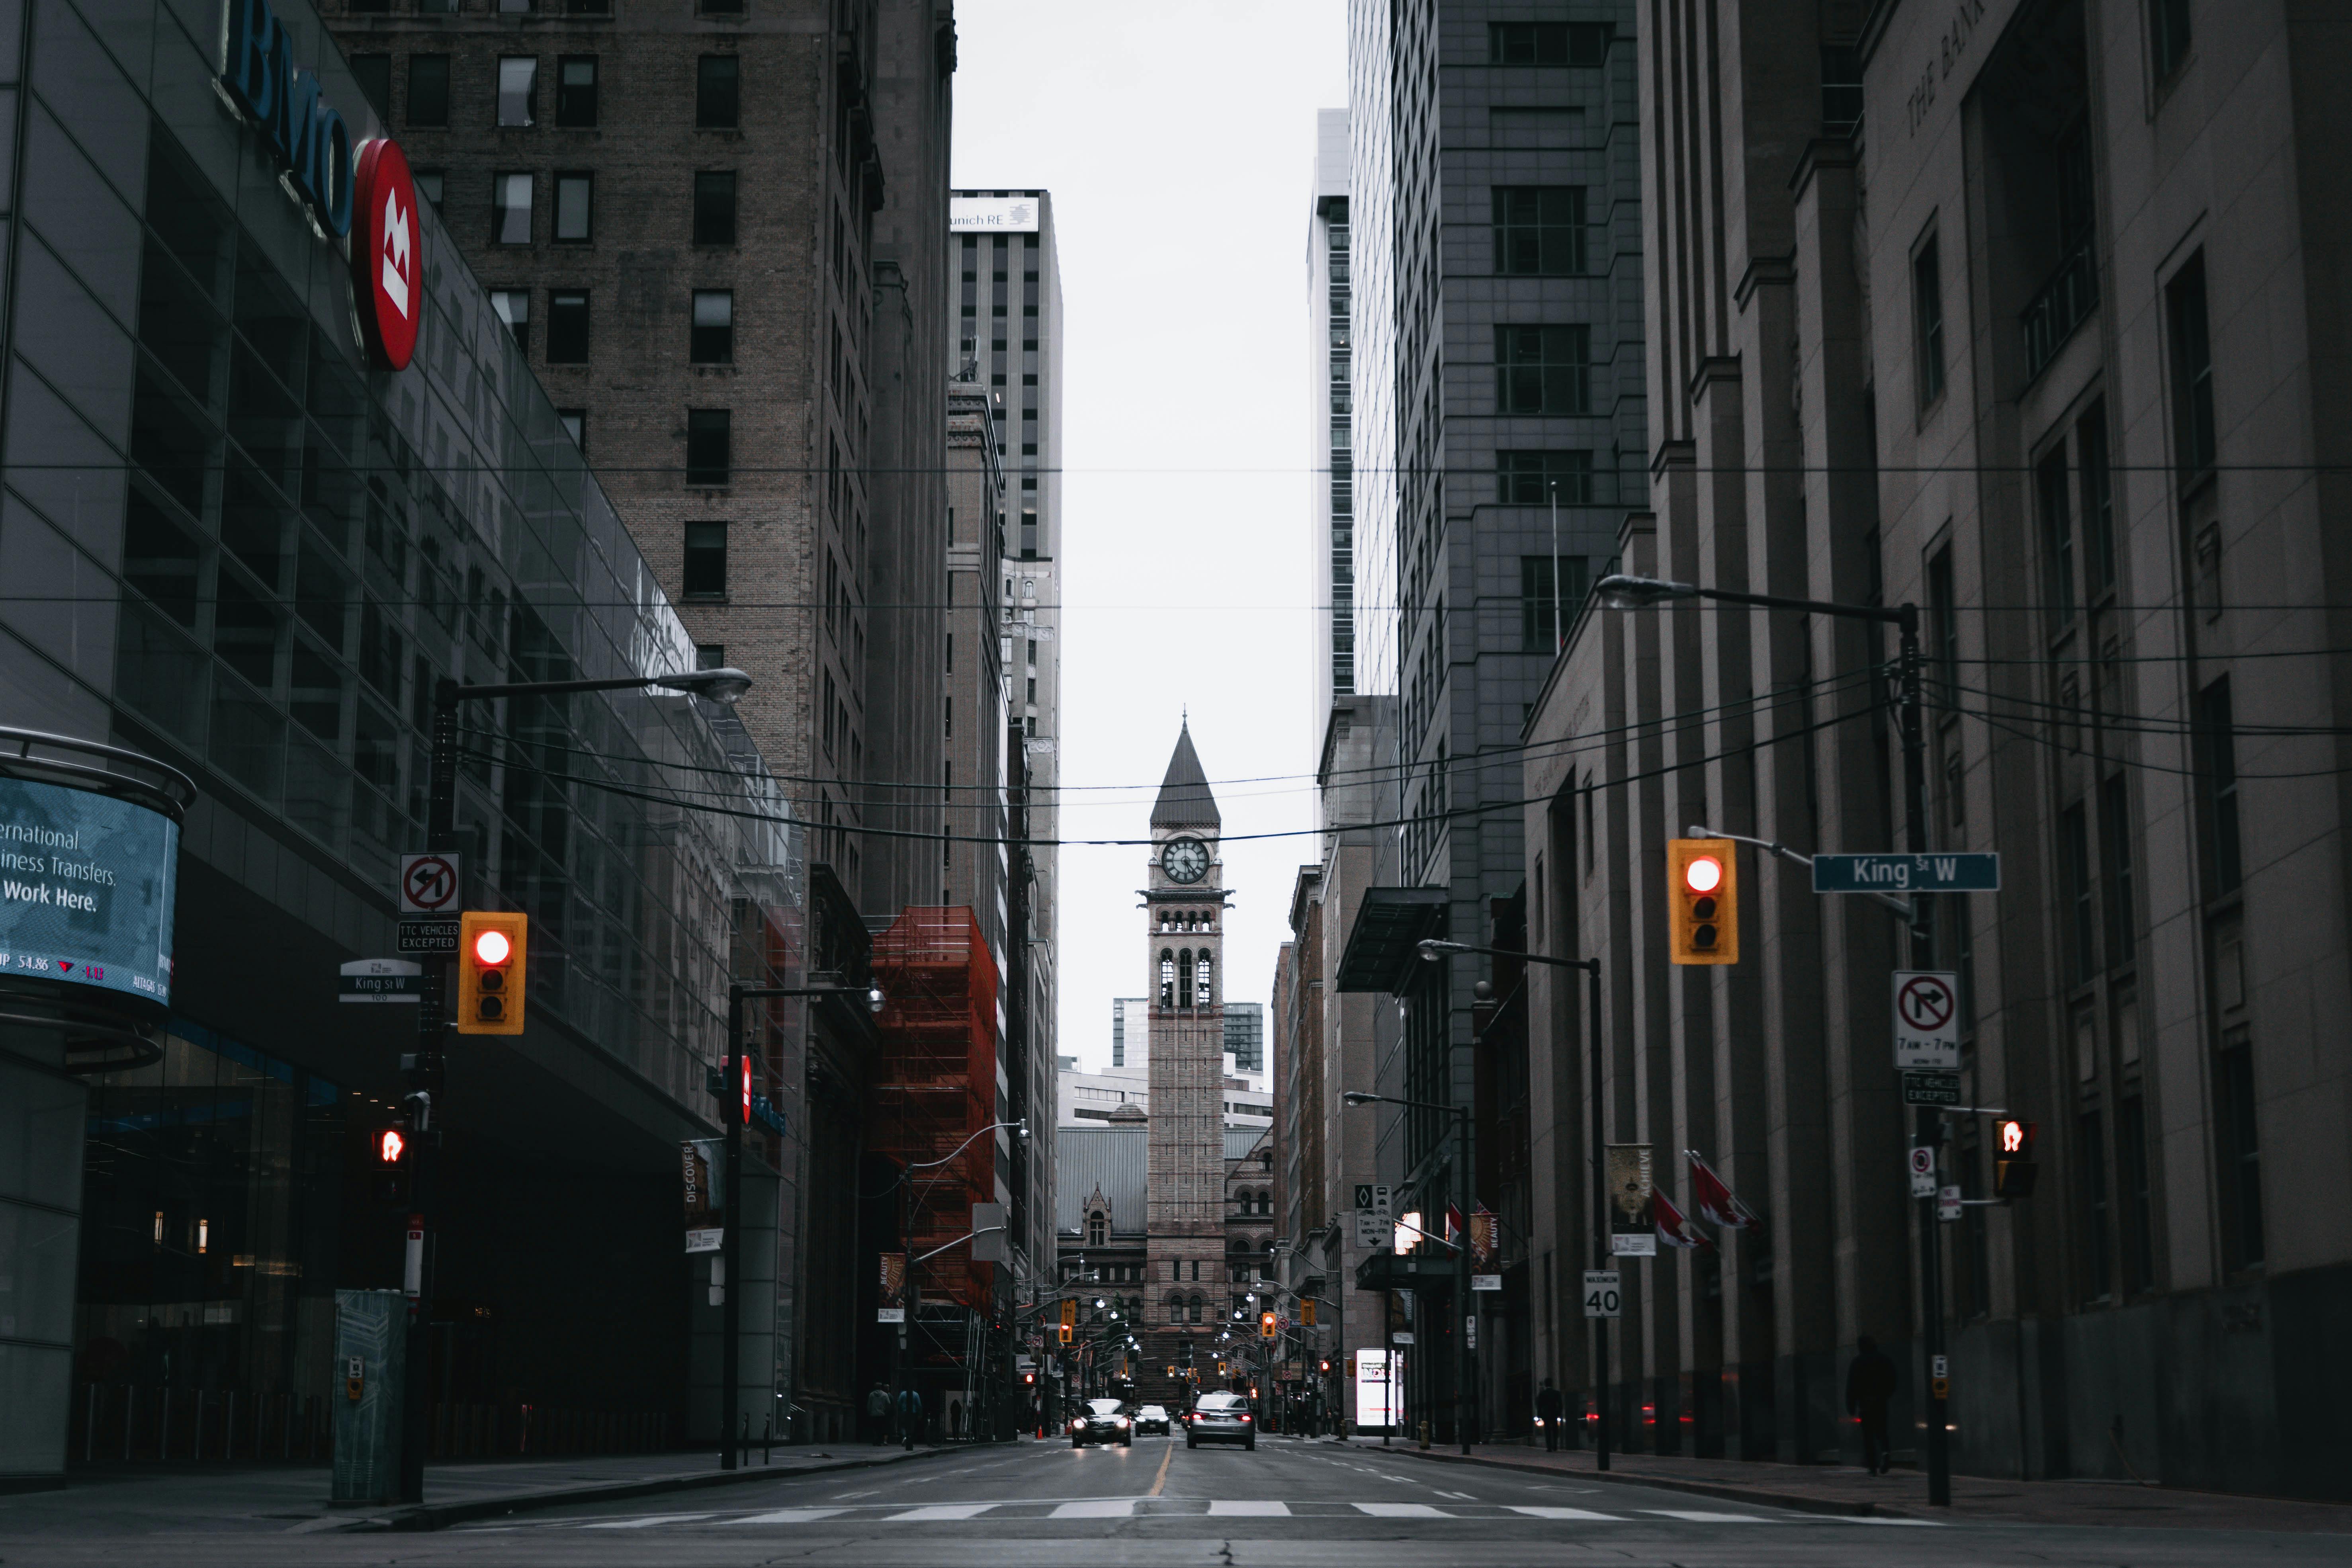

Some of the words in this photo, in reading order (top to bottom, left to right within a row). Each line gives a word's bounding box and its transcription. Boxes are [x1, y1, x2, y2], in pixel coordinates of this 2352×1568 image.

[1907, 61, 1936, 138] THE
[221, 0, 354, 238] BMO
[988, 215, 1003, 225] RE
[51, 856, 116, 886] Transfers.
[1853, 858, 1910, 889] King
[1916, 859, 1930, 871] St
[1934, 858, 1957, 882] W
[3, 879, 50, 905] Work
[56, 887, 97, 913] Here.
[401, 926, 417, 935] TTC
[420, 925, 458, 935] VEHICLES
[402, 938, 455, 948] EXCEPTED
[18, 956, 49, 972] 54.86
[356, 977, 381, 992] King
[385, 980, 393, 989] St
[396, 978, 405, 989] W
[1905, 1077, 1921, 1087] TTC
[1924, 1077, 1960, 1089] VEHICLES
[1908, 1090, 1957, 1102] EXCEPTED
[684, 1146, 697, 1203] DISCOVER
[1639, 1149, 1651, 1197] ACHIEVE
[1490, 1217, 1498, 1248] BEAUTY
[1586, 1290, 1619, 1312] 40
